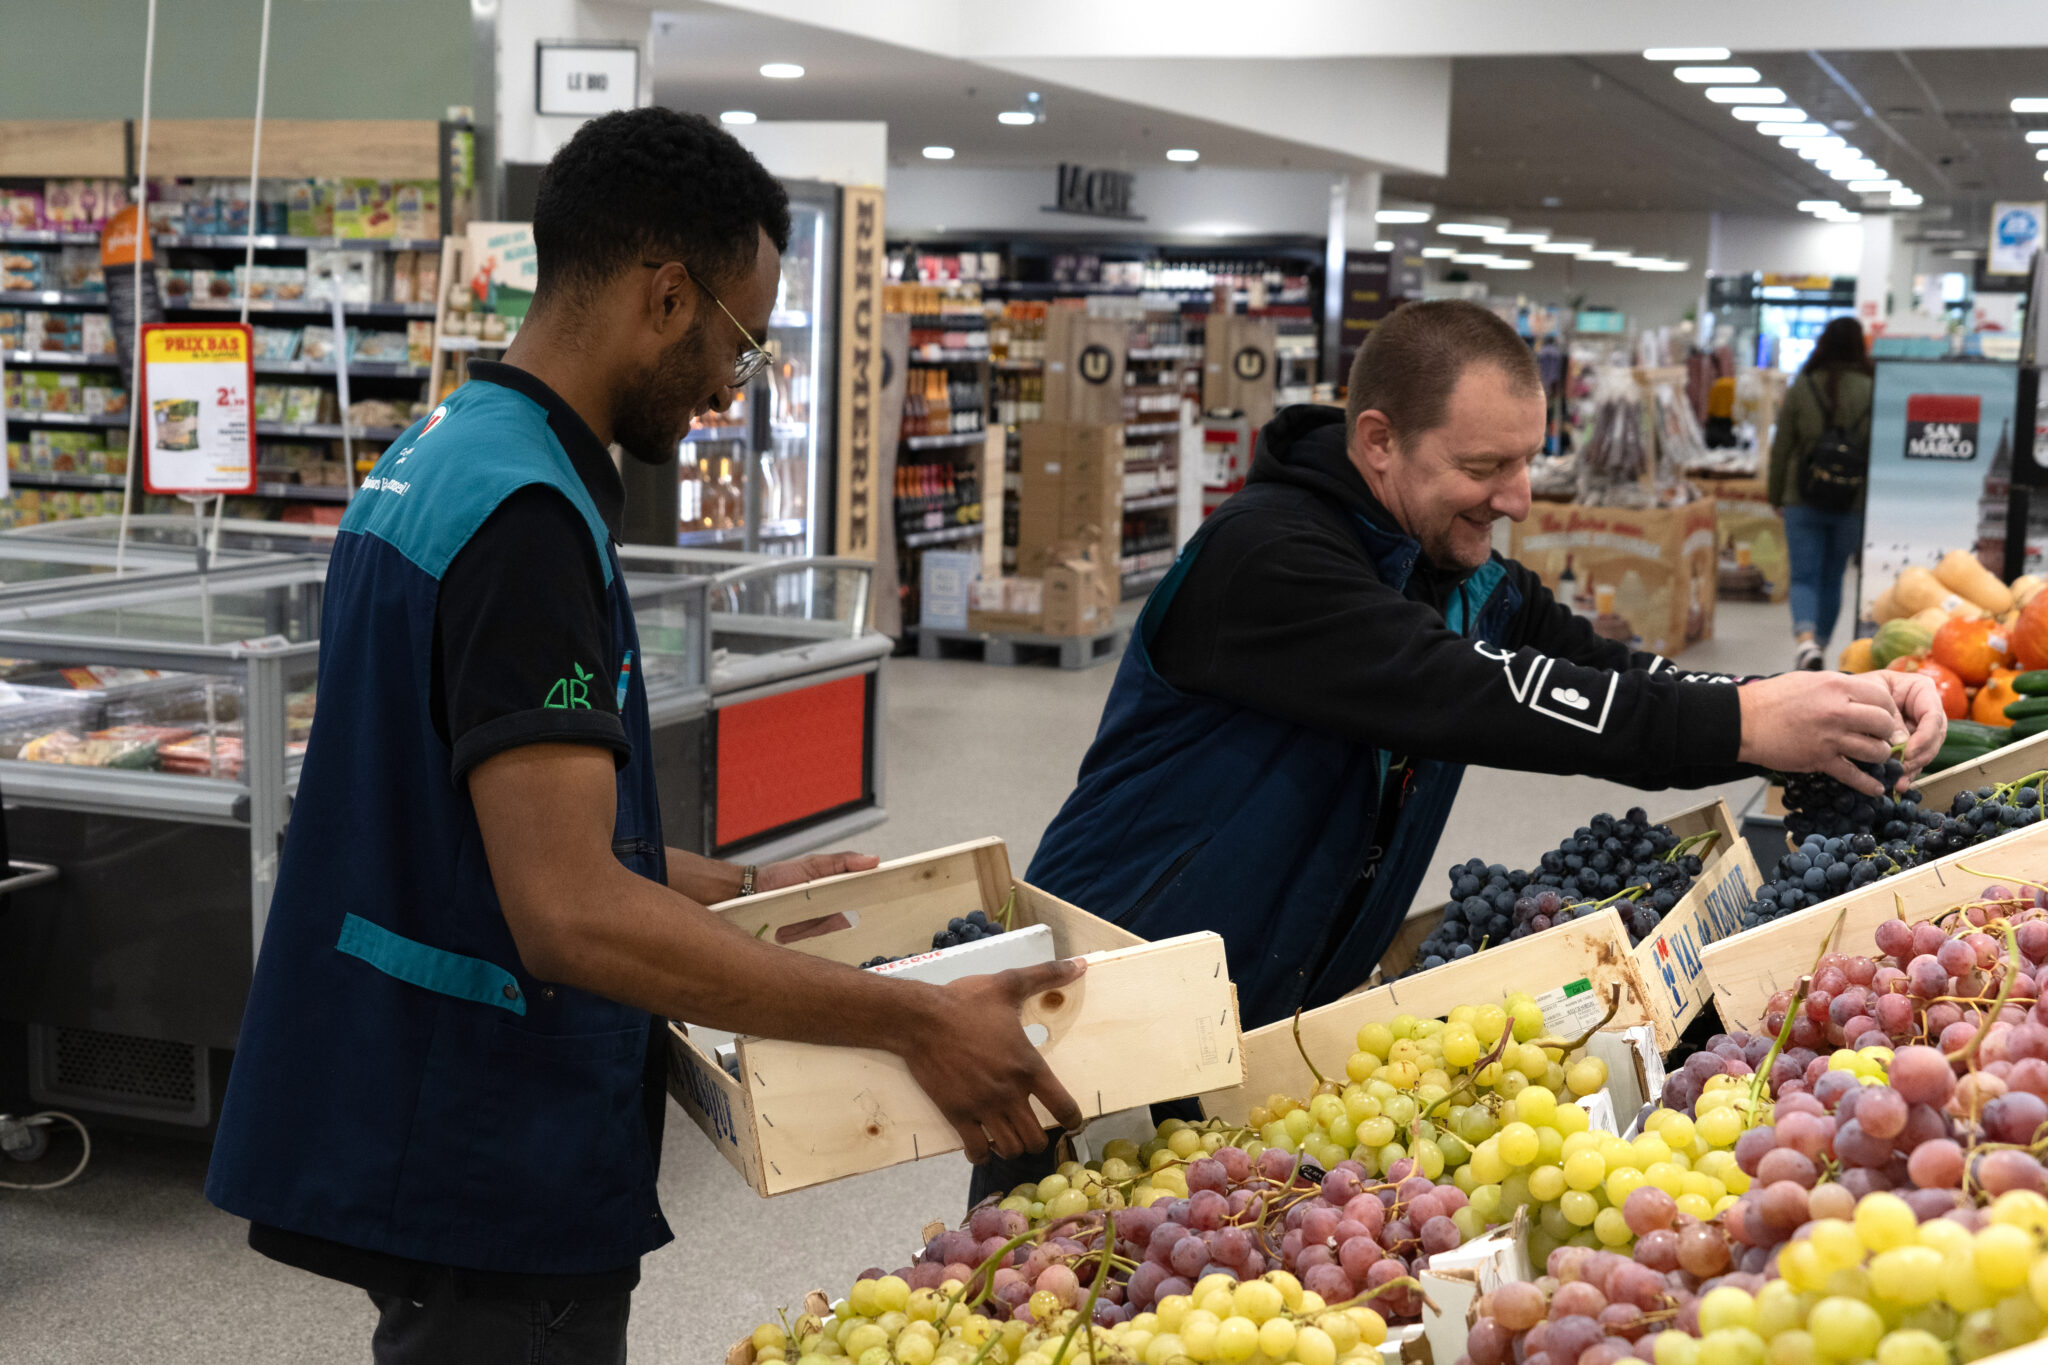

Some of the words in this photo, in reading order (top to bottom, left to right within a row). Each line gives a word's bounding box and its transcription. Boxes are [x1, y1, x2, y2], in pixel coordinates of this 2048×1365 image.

[566, 73, 582, 91] LE
[586, 73, 609, 91] BIO
[165, 336, 203, 353] PRIX
[206, 336, 240, 352] BAS
[850, 198, 876, 549] RHUMERIE
[1923, 422, 1962, 441] SAN
[1907, 438, 1975, 459] MARCO
